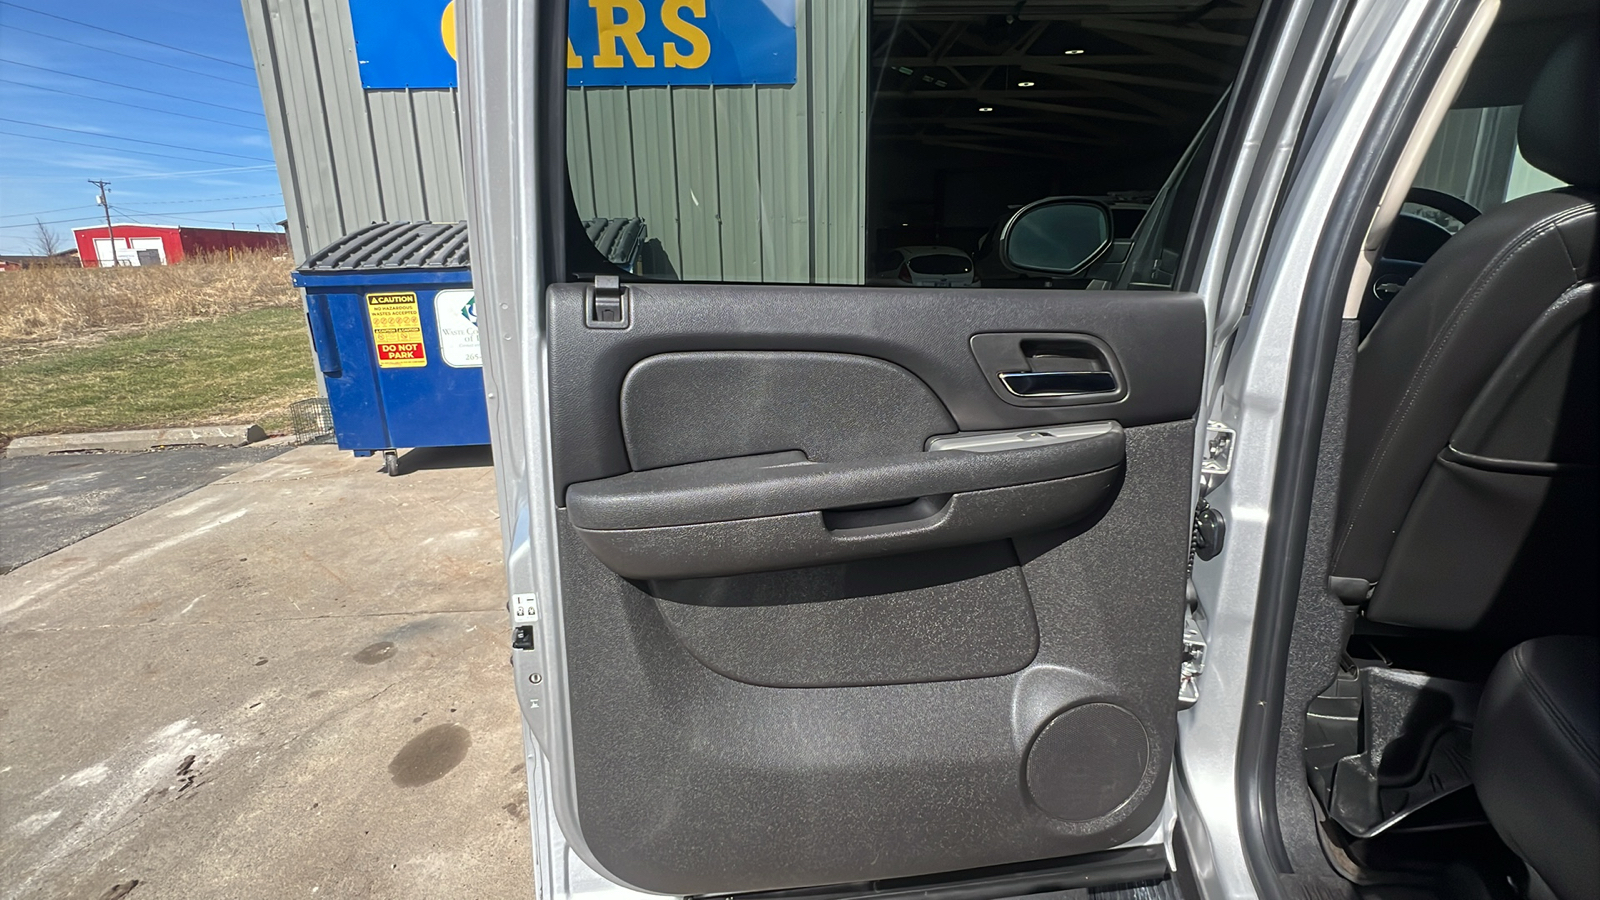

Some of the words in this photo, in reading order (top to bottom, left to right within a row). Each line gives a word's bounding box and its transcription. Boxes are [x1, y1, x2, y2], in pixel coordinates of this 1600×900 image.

[382, 344, 396, 352] DO
[398, 343, 418, 351] NOT
[388, 351, 414, 359] PARK
